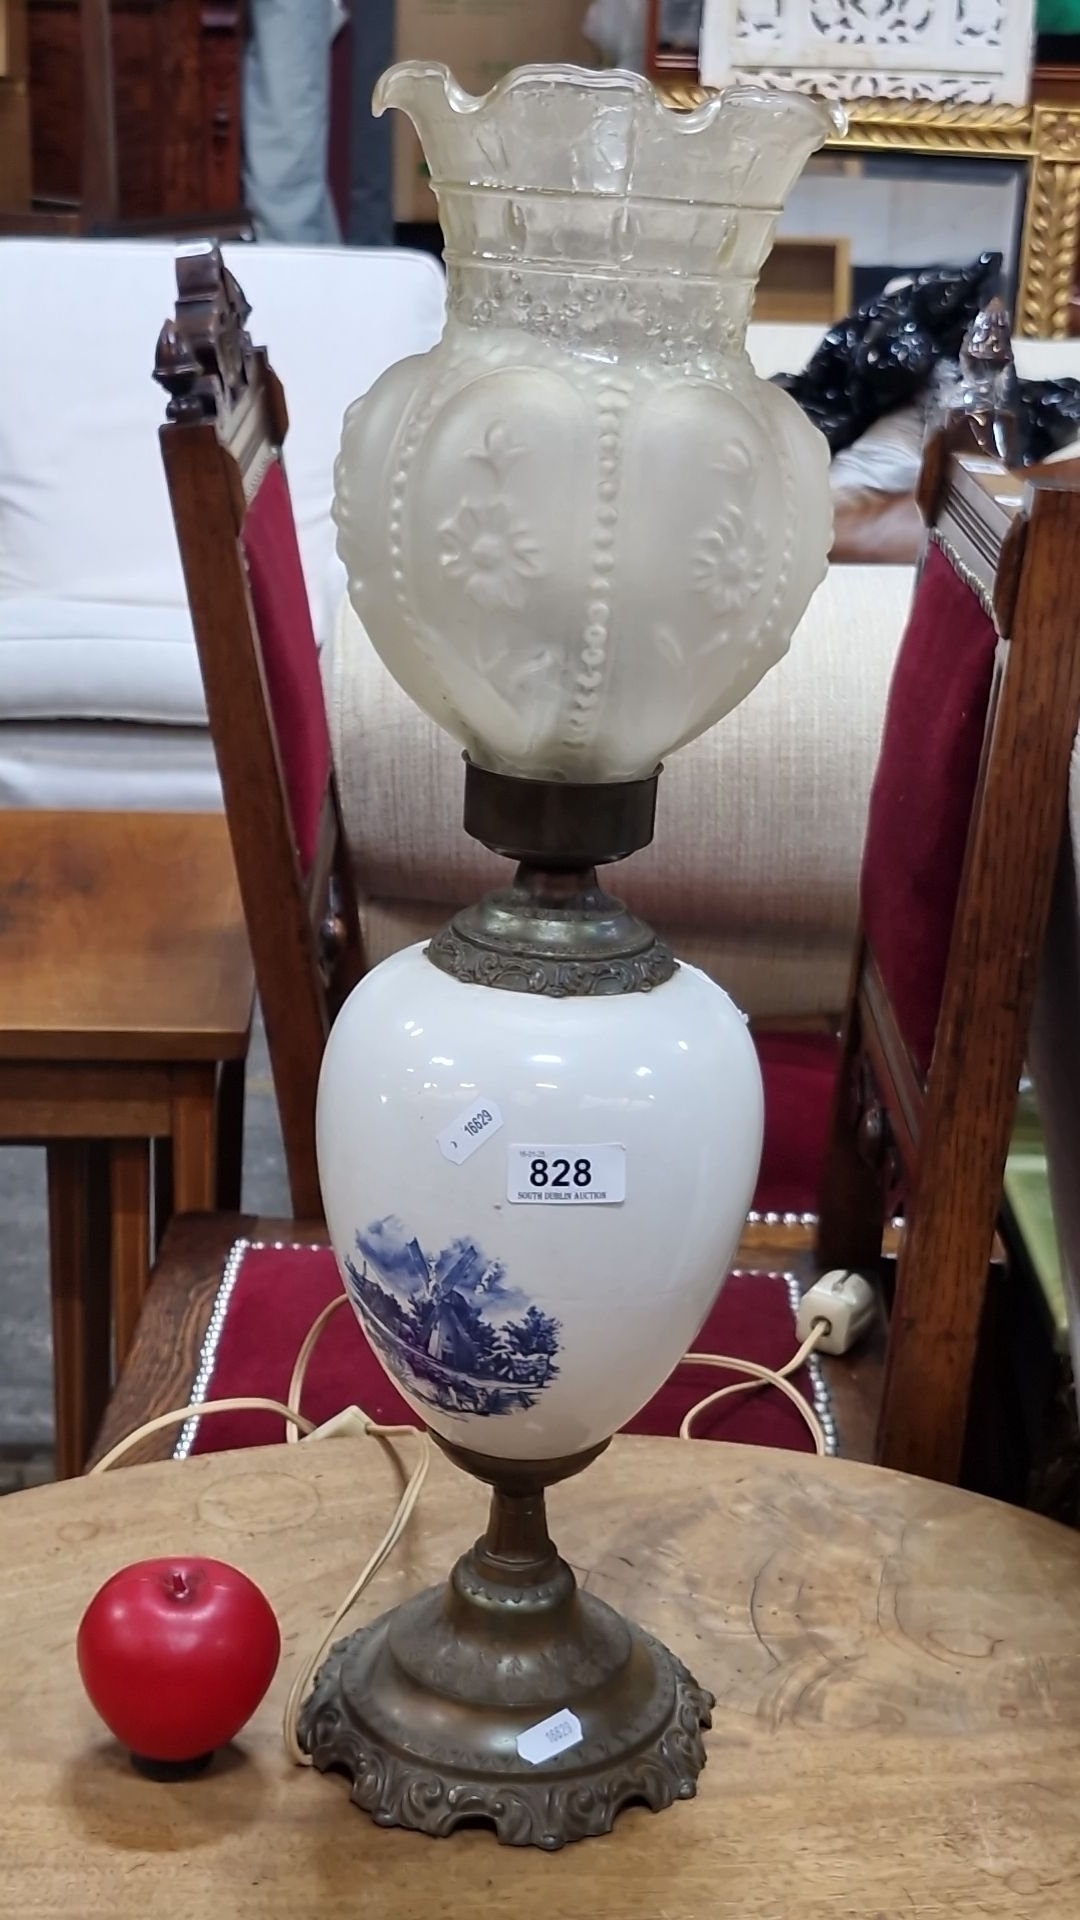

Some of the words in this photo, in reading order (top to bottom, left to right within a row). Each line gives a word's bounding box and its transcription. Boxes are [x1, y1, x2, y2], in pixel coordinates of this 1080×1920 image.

[464, 1109, 493, 1137] 16629
[529, 1158, 592, 1187] 828
[518, 1191, 543, 1200] SOUTH
[545, 1191, 572, 1200] DUBLIN
[573, 1191, 607, 1200] AUCTION
